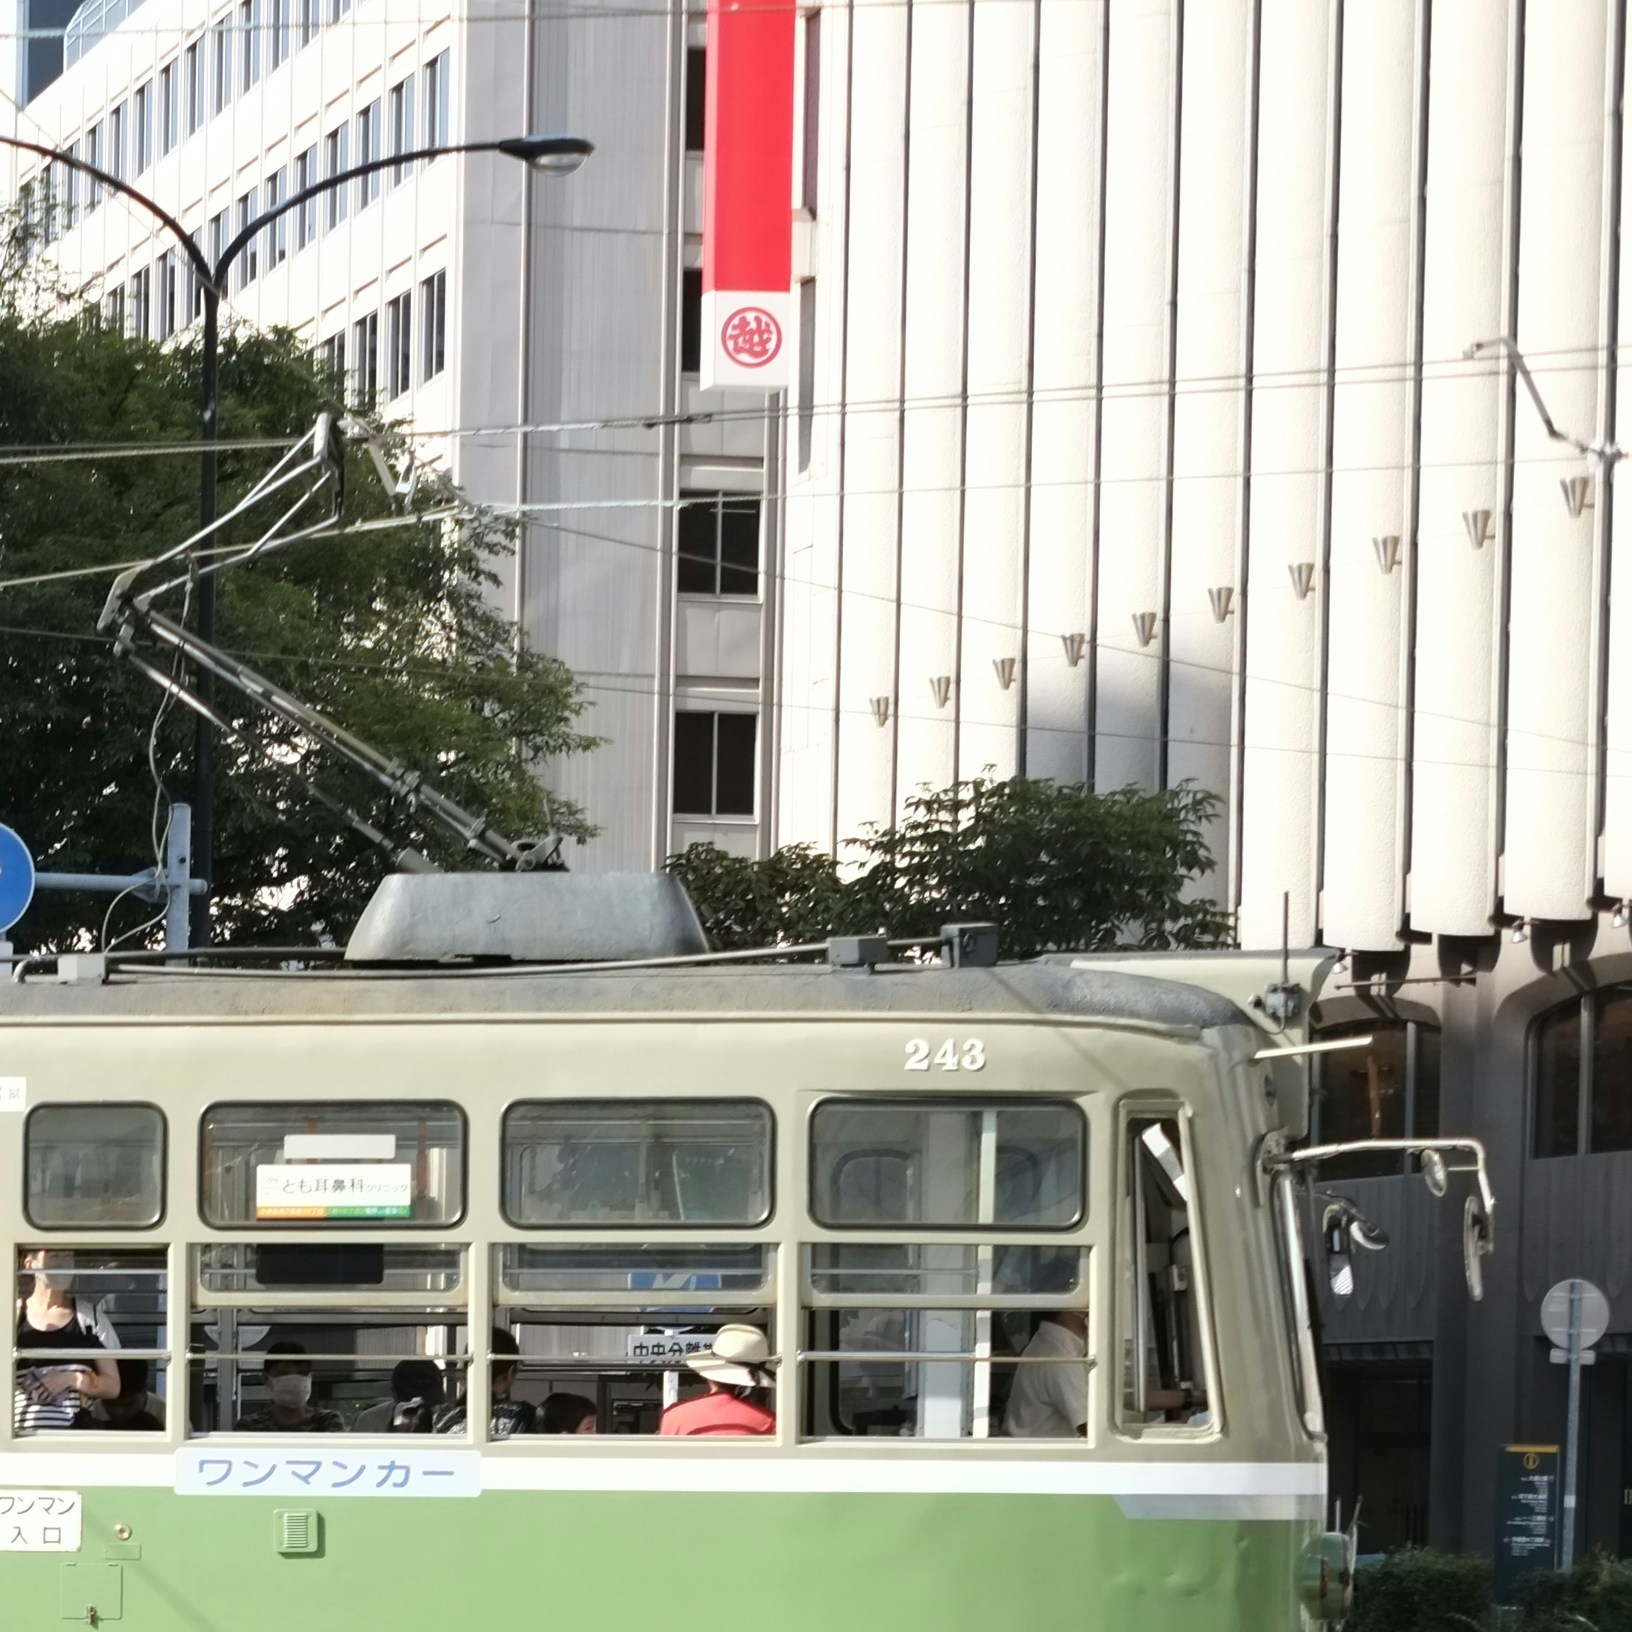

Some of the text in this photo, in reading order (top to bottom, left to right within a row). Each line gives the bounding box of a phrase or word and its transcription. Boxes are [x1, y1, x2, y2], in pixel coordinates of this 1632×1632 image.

[904, 1037, 986, 1072] 243
[198, 1458, 455, 1488] ワンマンカー
[10, 1525, 62, 1546] 入口
